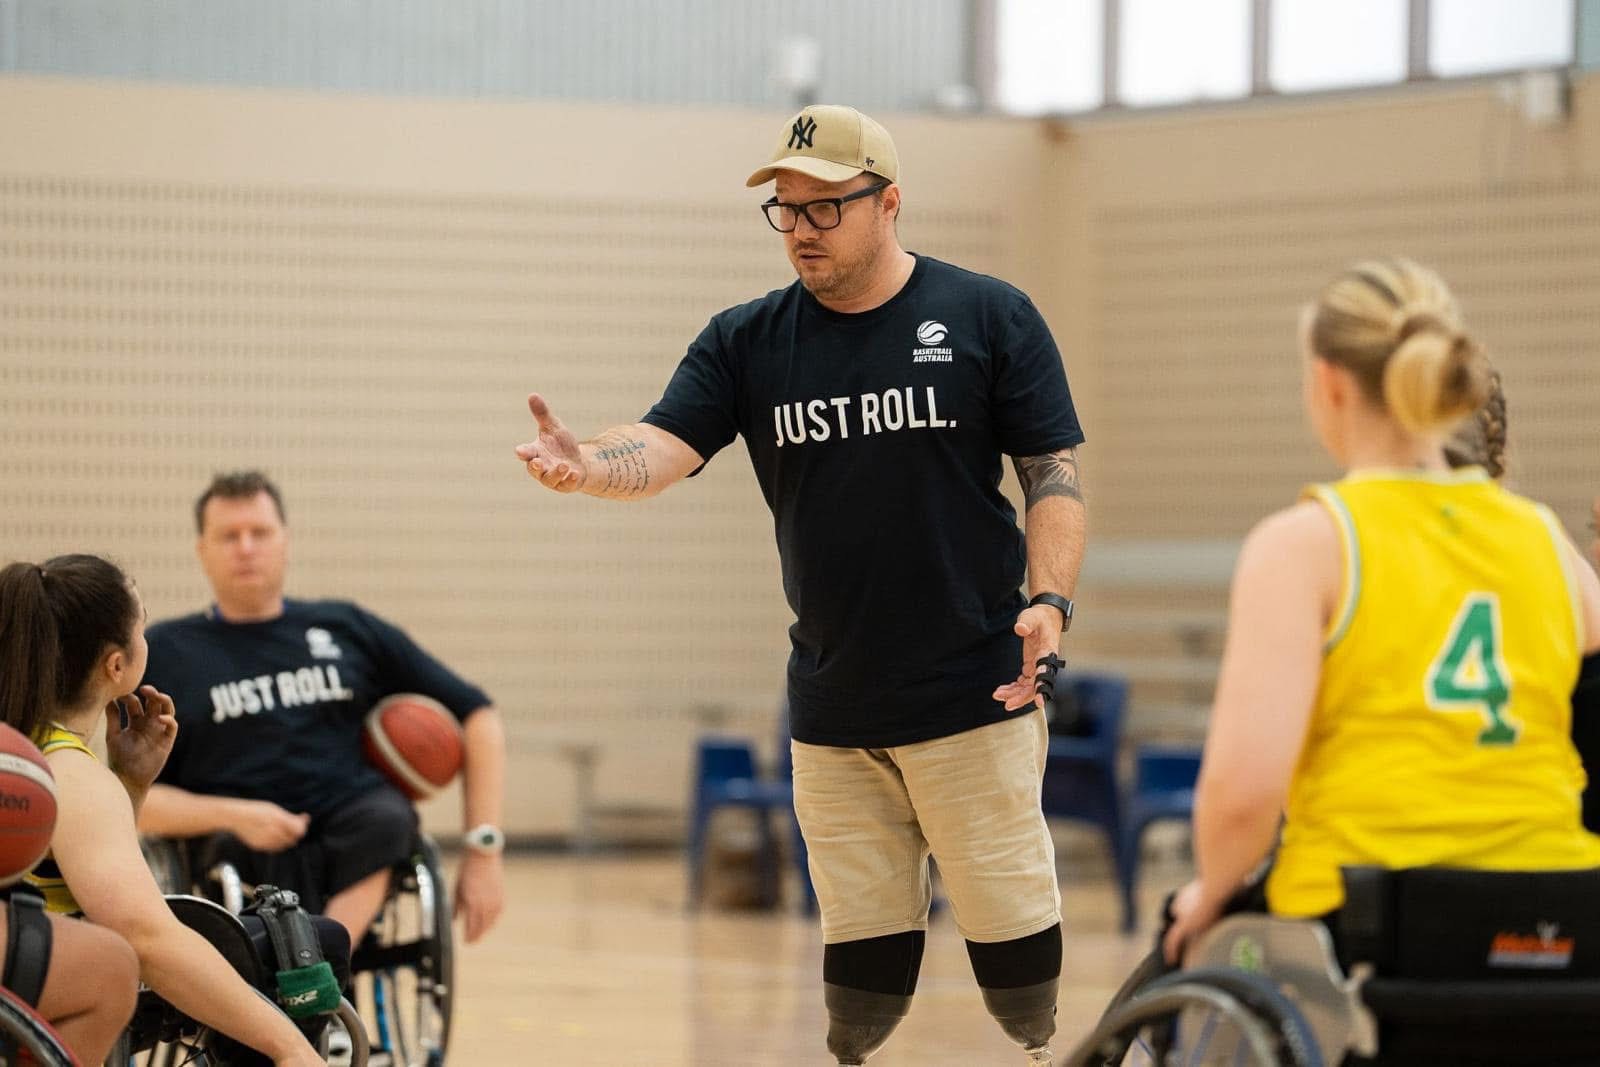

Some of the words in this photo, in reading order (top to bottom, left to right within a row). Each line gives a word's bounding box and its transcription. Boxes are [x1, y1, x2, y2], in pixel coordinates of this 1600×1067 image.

[787, 116, 817, 150] NY
[912, 348, 953, 356] BASKETBALL
[913, 355, 953, 363] AUSTRALIA
[774, 396, 850, 447] JUST
[861, 386, 957, 435] ROLL.
[1425, 592, 1520, 746] 4
[210, 674, 275, 723] JUST
